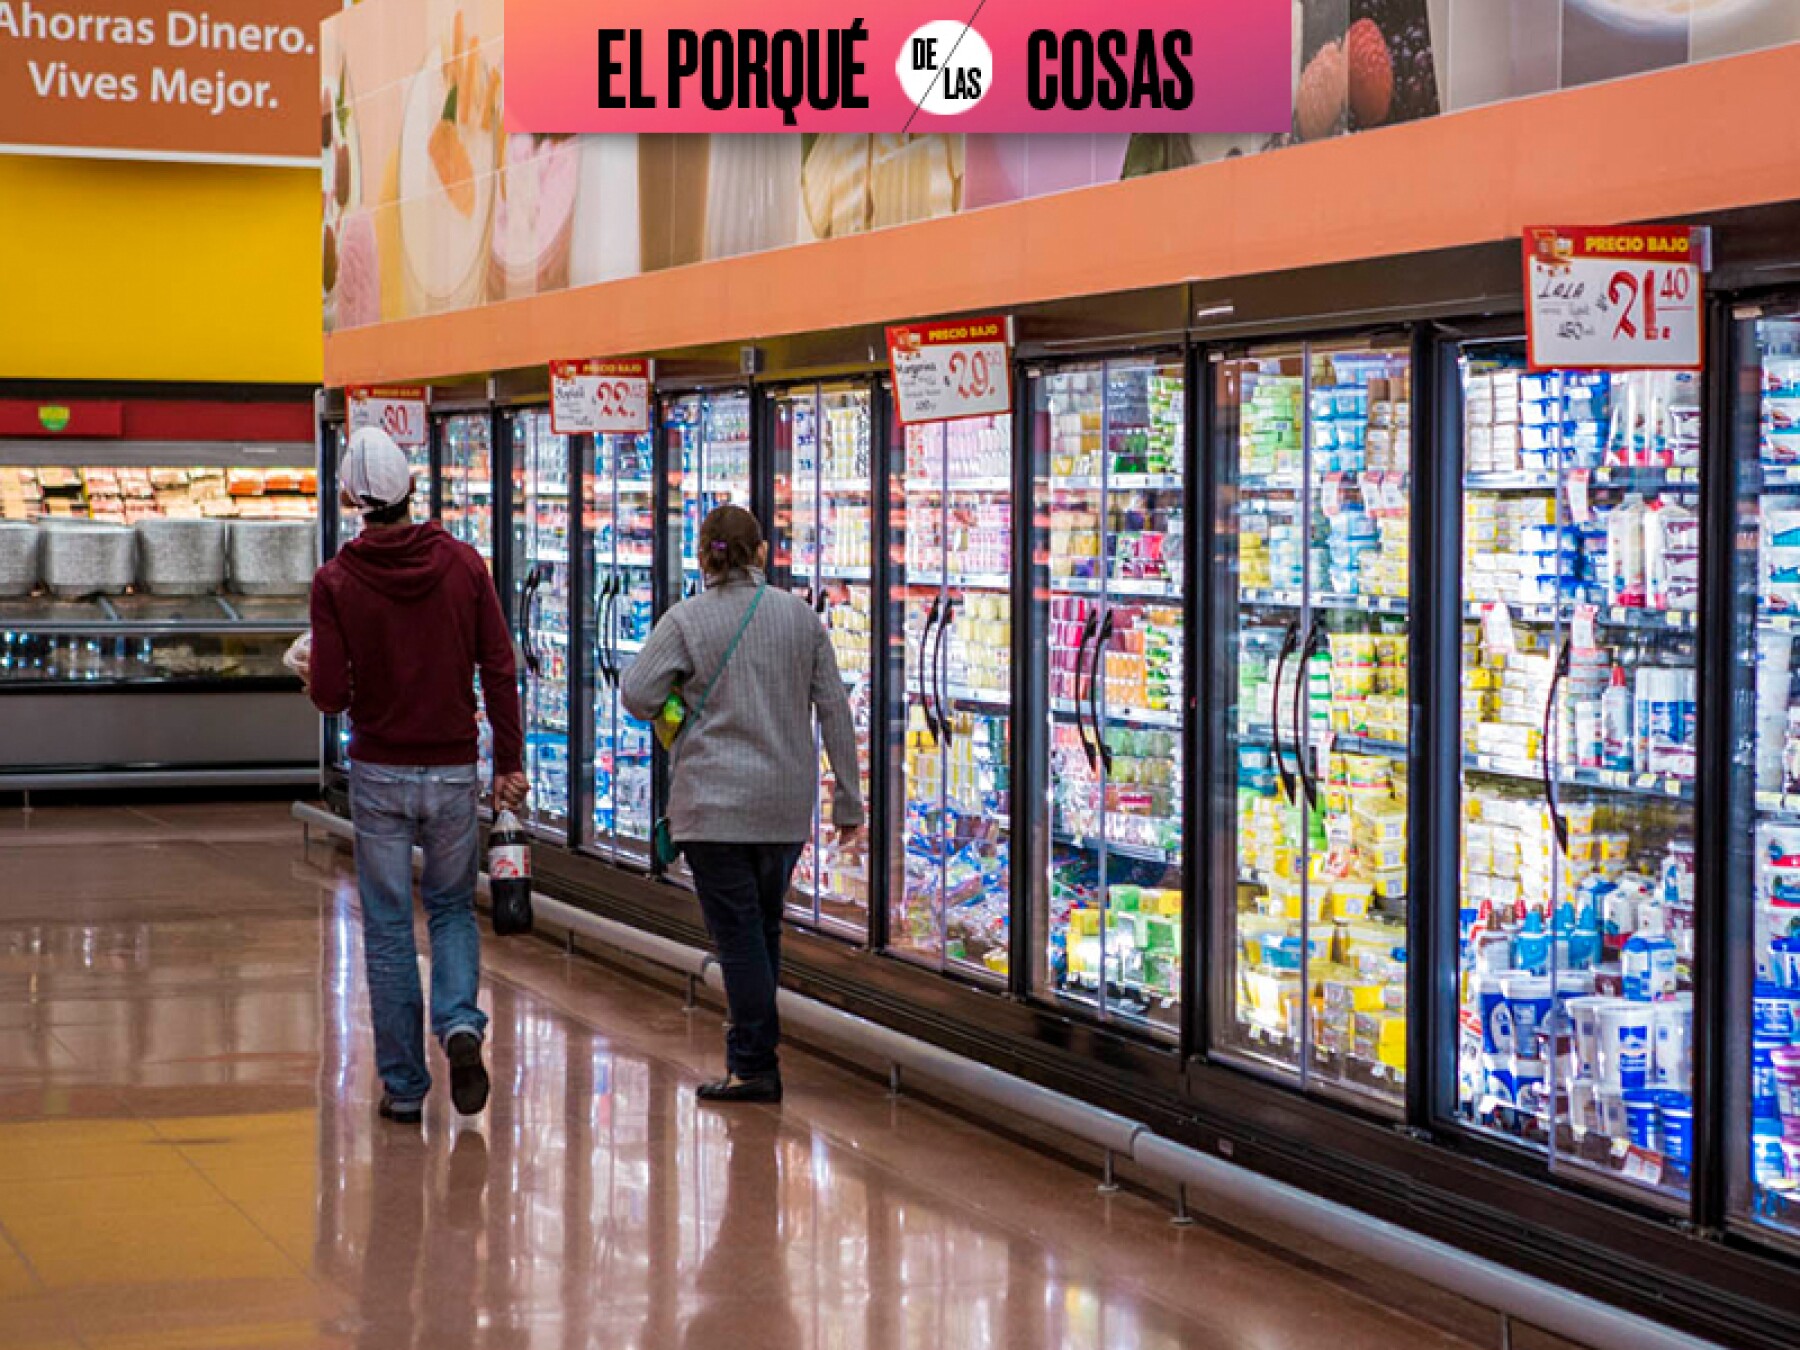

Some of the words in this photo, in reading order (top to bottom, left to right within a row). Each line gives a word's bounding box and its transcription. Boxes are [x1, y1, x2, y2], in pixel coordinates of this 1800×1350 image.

[0, 1, 155, 46] Ahorras
[167, 11, 315, 54] Dinero.
[27, 60, 139, 101] Vives
[151, 67, 279, 115] Mejor.
[1584, 236, 1643, 252] PRECIO
[1646, 235, 1690, 252] BAJO
